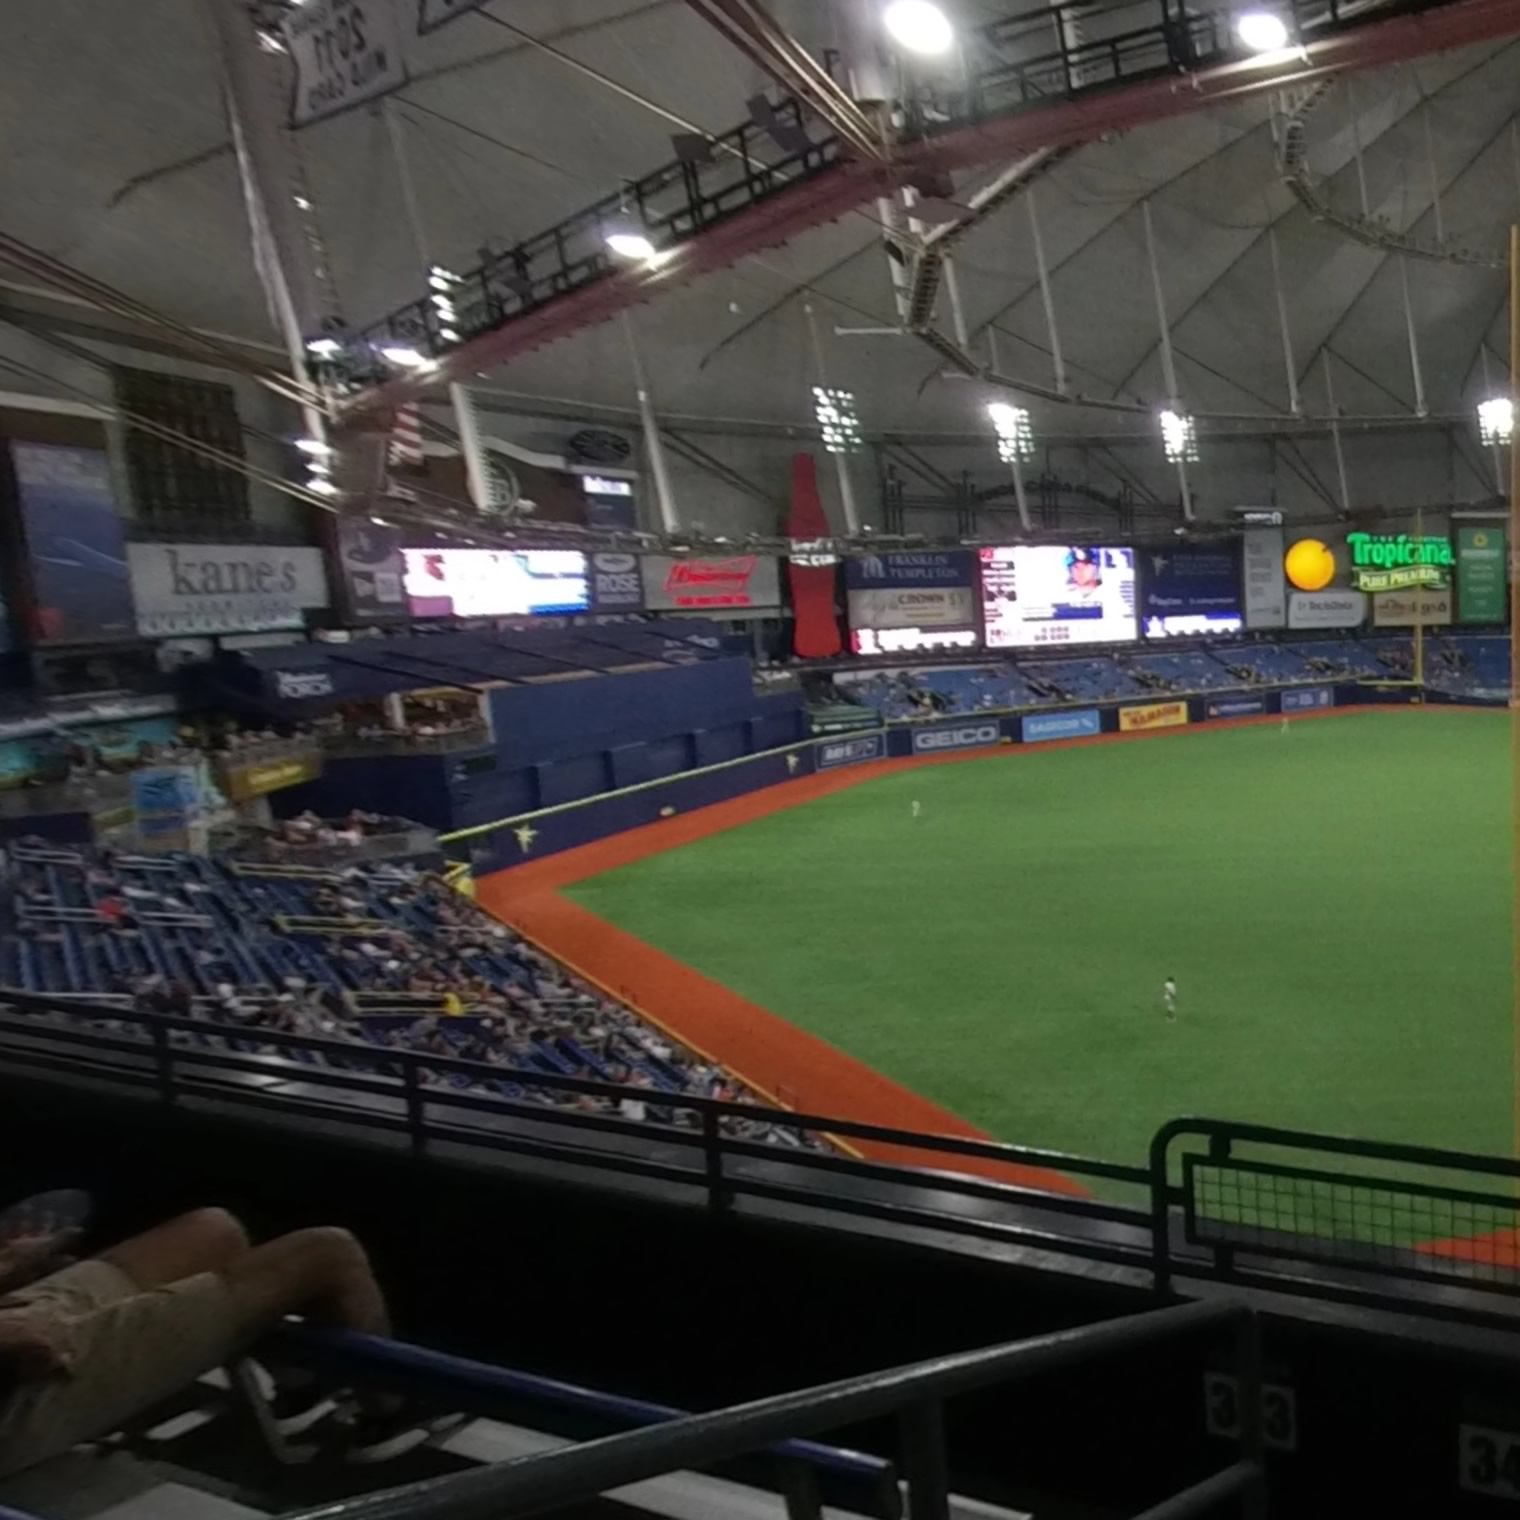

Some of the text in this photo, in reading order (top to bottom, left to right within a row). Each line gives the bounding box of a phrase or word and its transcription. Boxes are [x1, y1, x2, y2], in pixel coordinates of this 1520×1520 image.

[1347, 533, 1452, 567] Tropicana
[596, 573, 641, 593] ROSE
[915, 724, 997, 749] GEICO
[1211, 1381, 1291, 1440] 33
